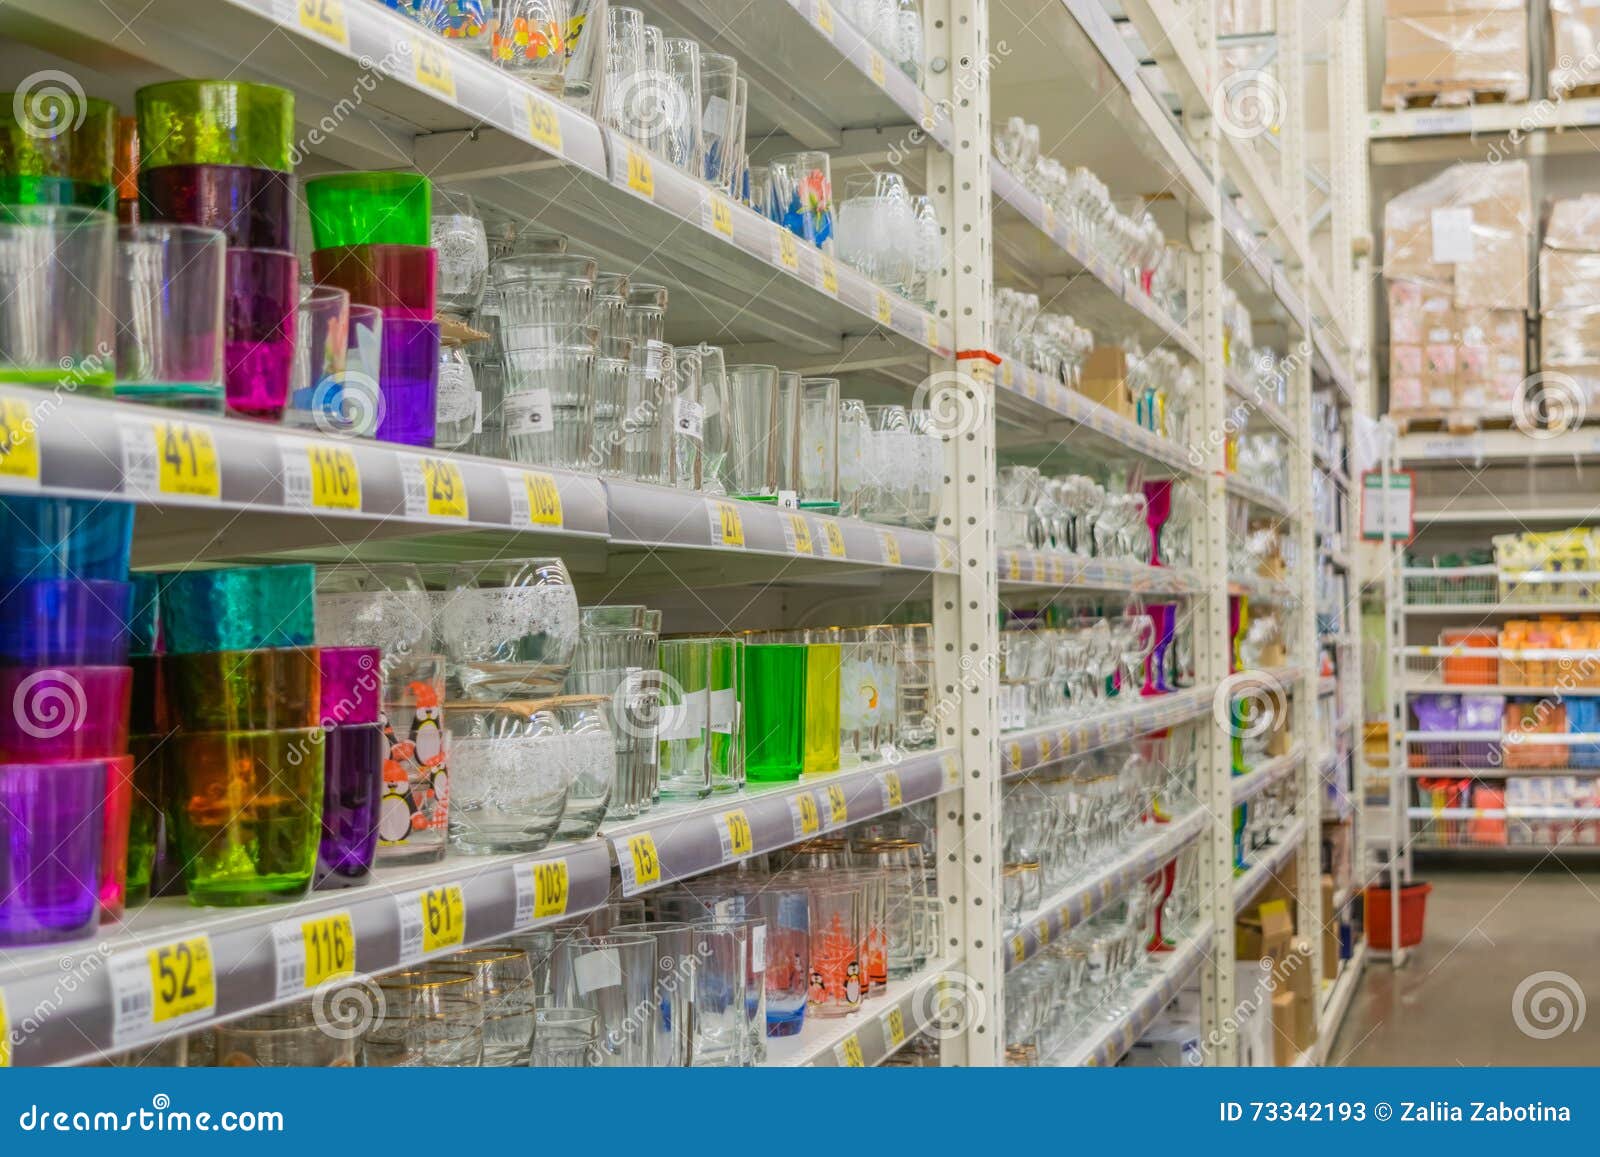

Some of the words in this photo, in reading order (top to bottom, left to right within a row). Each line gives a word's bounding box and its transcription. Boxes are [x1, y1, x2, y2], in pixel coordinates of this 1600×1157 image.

[165, 421, 197, 477] 41
[314, 447, 350, 496] 116
[424, 458, 453, 501] 29
[527, 475, 556, 516] 103
[729, 815, 745, 849] 27
[633, 837, 652, 877] 15
[539, 863, 562, 906] 103
[427, 886, 452, 936] 61
[312, 919, 346, 976] 116
[158, 942, 197, 1005] 52
